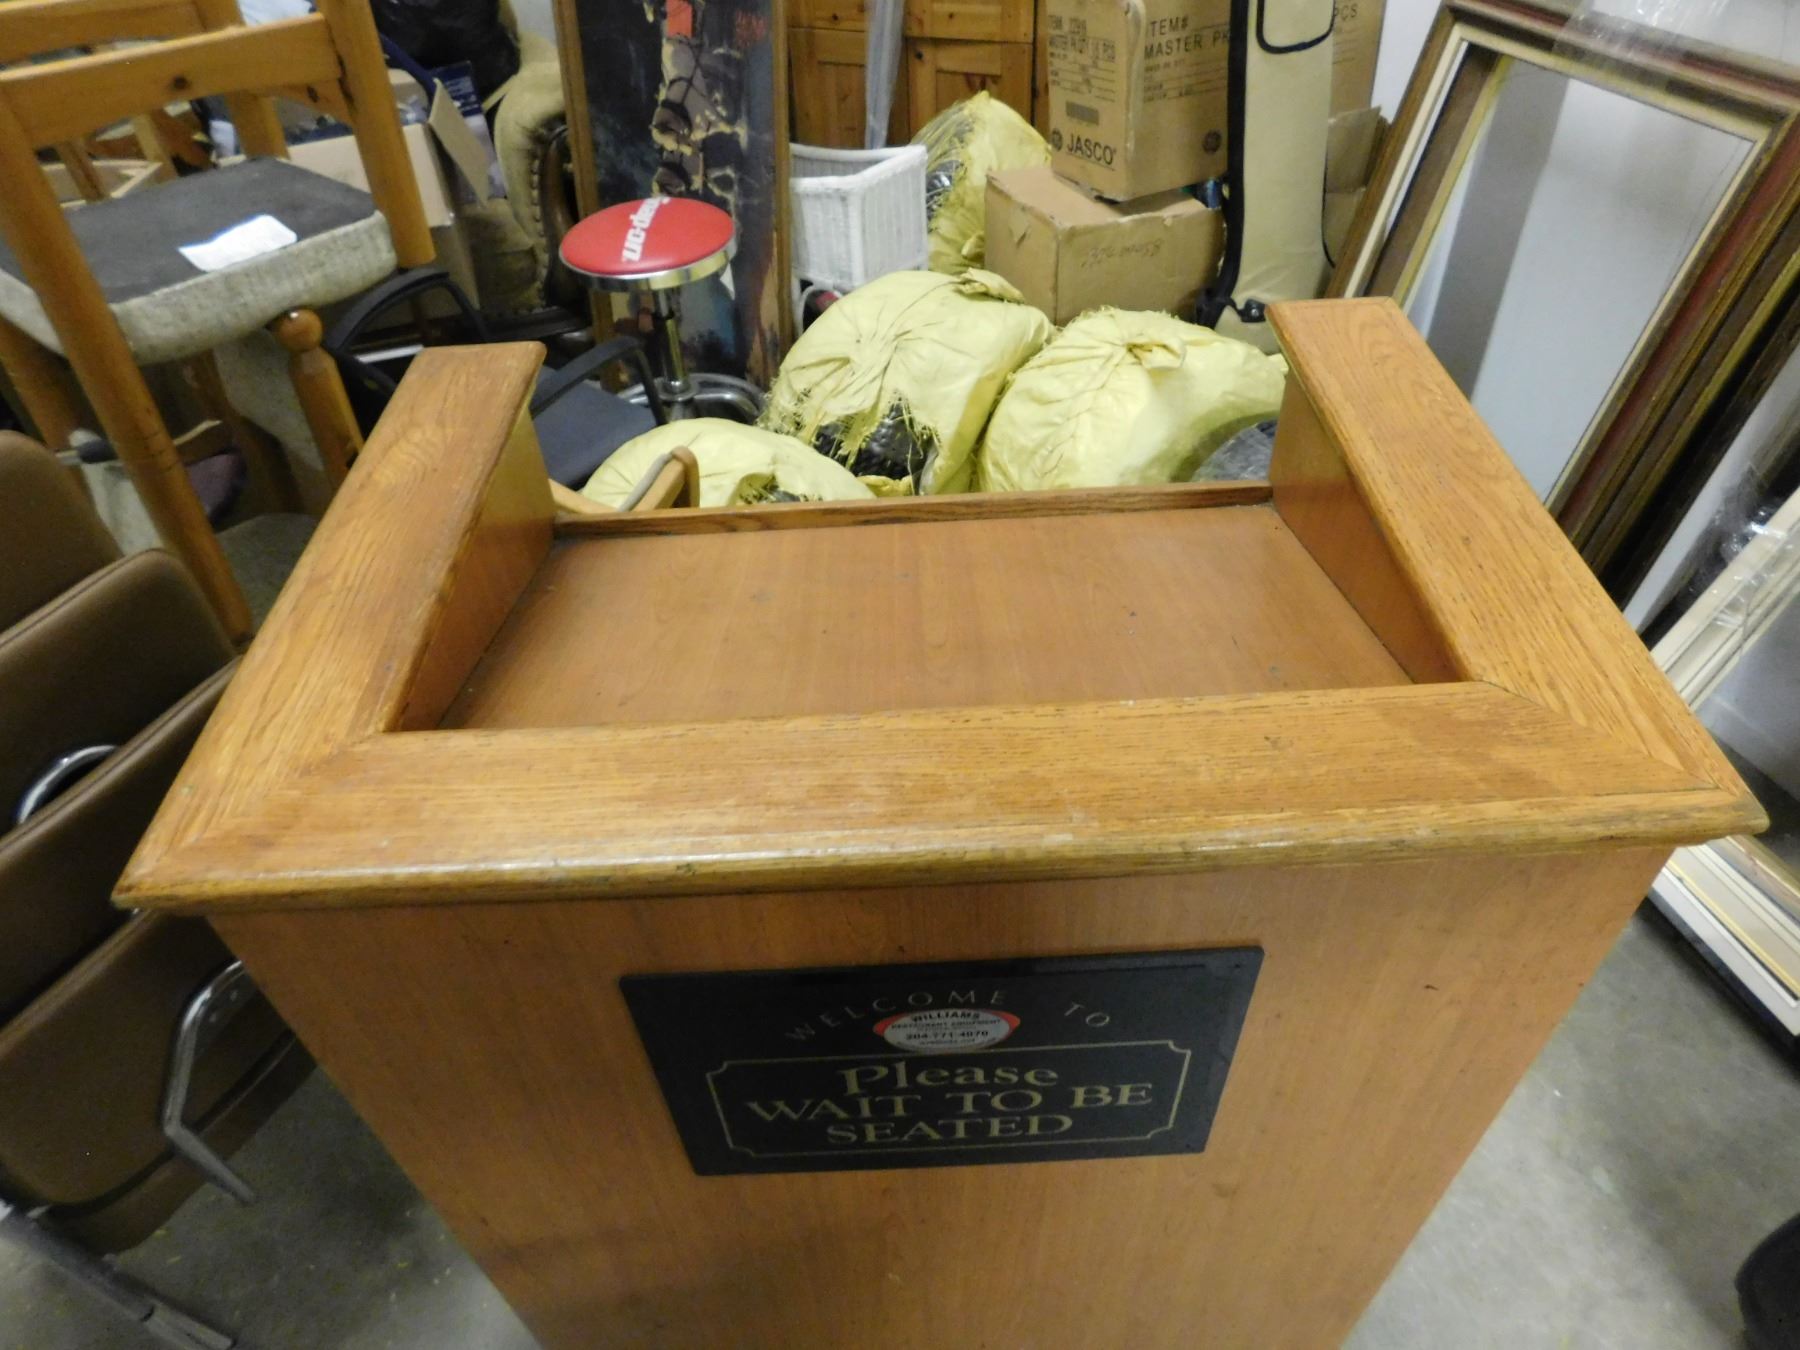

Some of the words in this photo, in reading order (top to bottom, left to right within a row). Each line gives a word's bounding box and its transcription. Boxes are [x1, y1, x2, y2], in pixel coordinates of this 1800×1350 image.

[1144, 33, 1202, 59] MASTER
[1067, 133, 1113, 165] JASCO
[785, 989, 1007, 1042] WELCOME
[1062, 1003, 1110, 1028] TO
[911, 1010, 981, 1022] WILLIAMS
[838, 1061, 1059, 1096] Please
[746, 1094, 922, 1122] WAIT
[945, 1088, 1043, 1115] TO
[1069, 1083, 1153, 1109] BE
[826, 1114, 1073, 1144] SEATED
